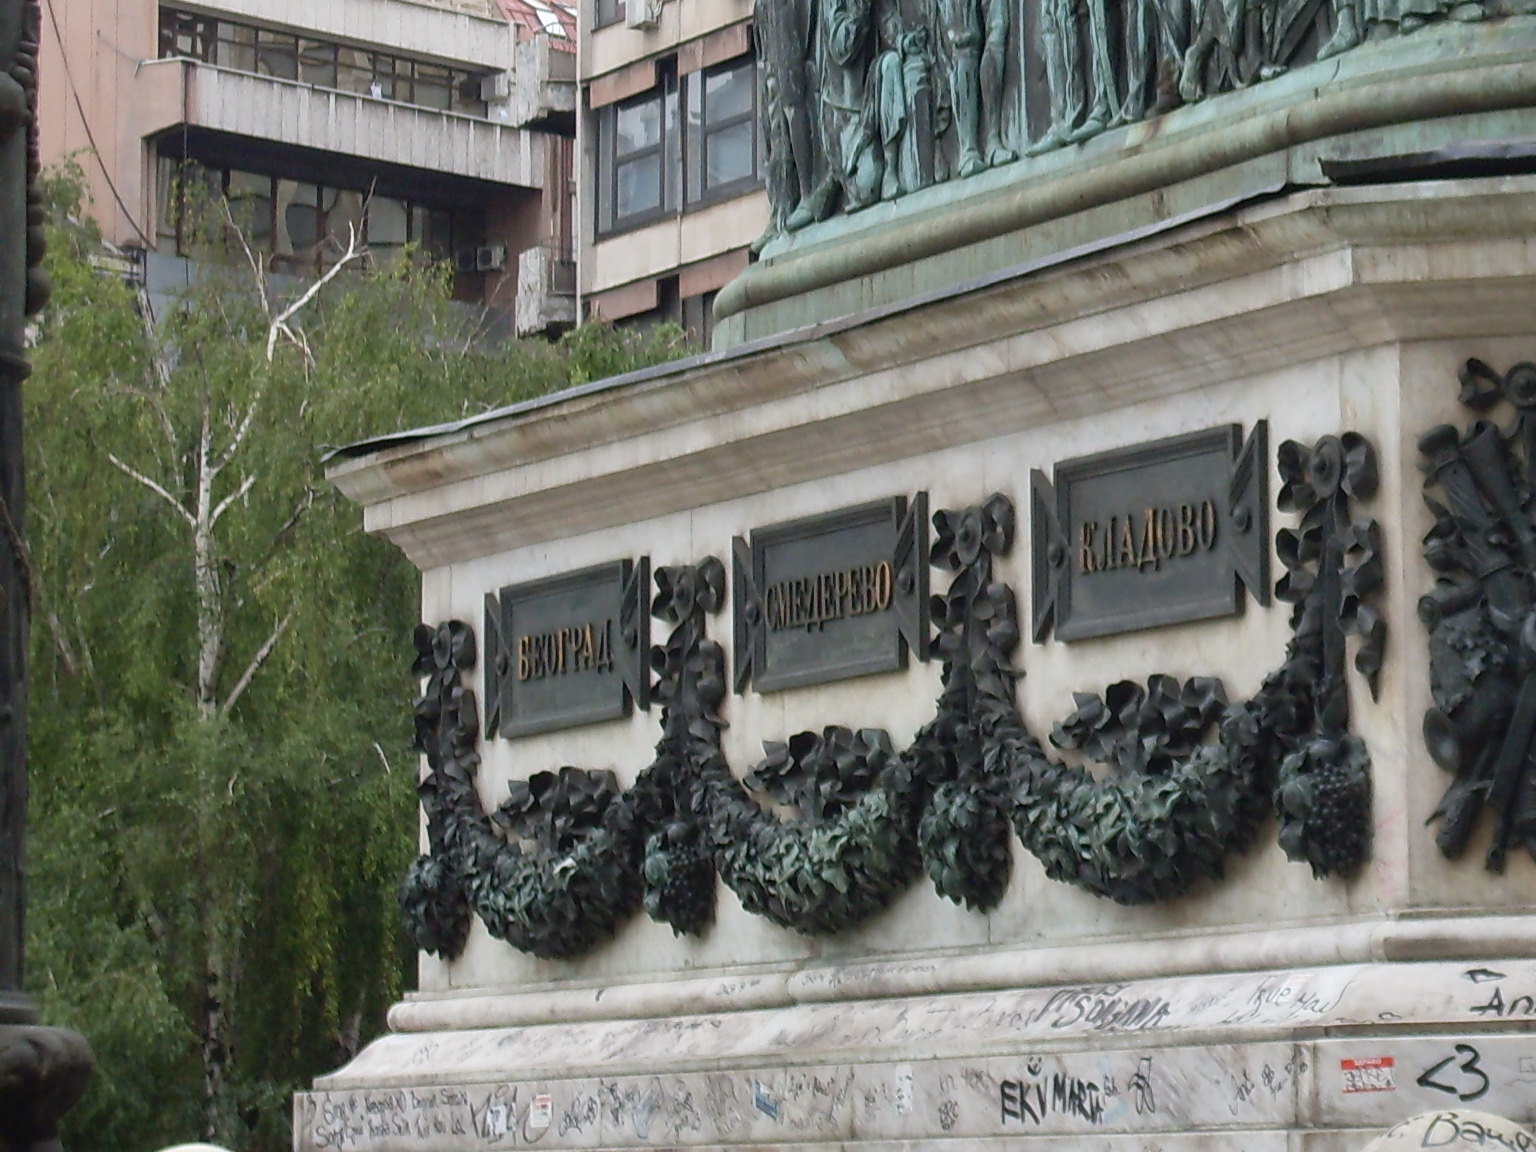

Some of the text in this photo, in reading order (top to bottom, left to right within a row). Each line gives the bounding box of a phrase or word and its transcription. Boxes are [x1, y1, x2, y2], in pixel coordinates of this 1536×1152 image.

[1079, 500, 1216, 576] КЛАДОВО
[765, 560, 893, 633] СМЕДЕРЕВО
[518, 618, 614, 682] БЕОГРАД
